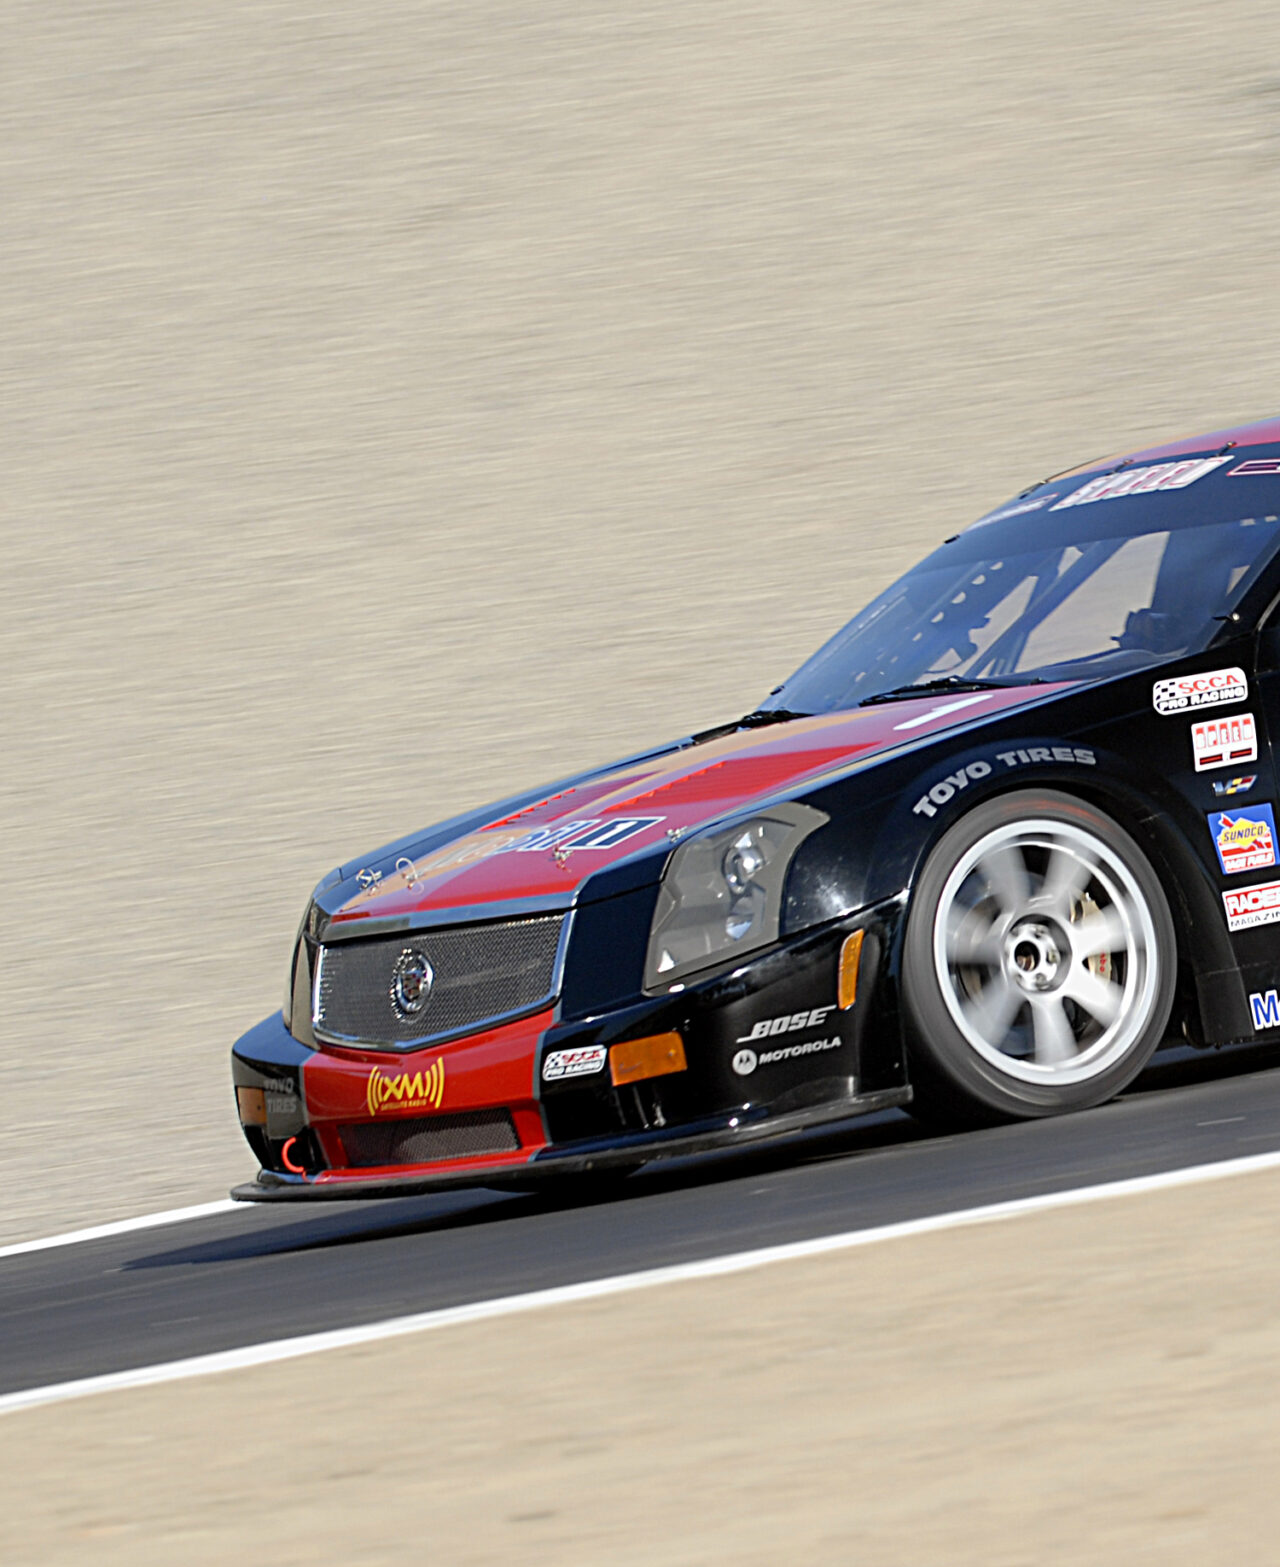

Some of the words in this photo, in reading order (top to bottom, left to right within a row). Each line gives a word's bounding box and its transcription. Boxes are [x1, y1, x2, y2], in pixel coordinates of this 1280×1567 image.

[1178, 674, 1240, 694] SCCA
[1159, 697, 1189, 711] PRO
[1190, 686, 1246, 705] RACING
[912, 761, 992, 818] TOYO
[996, 747, 1097, 767] TIRES
[1223, 826, 1264, 842] SUNOCO
[737, 1004, 836, 1043] BOSE
[759, 1036, 841, 1064] MOTOROLA
